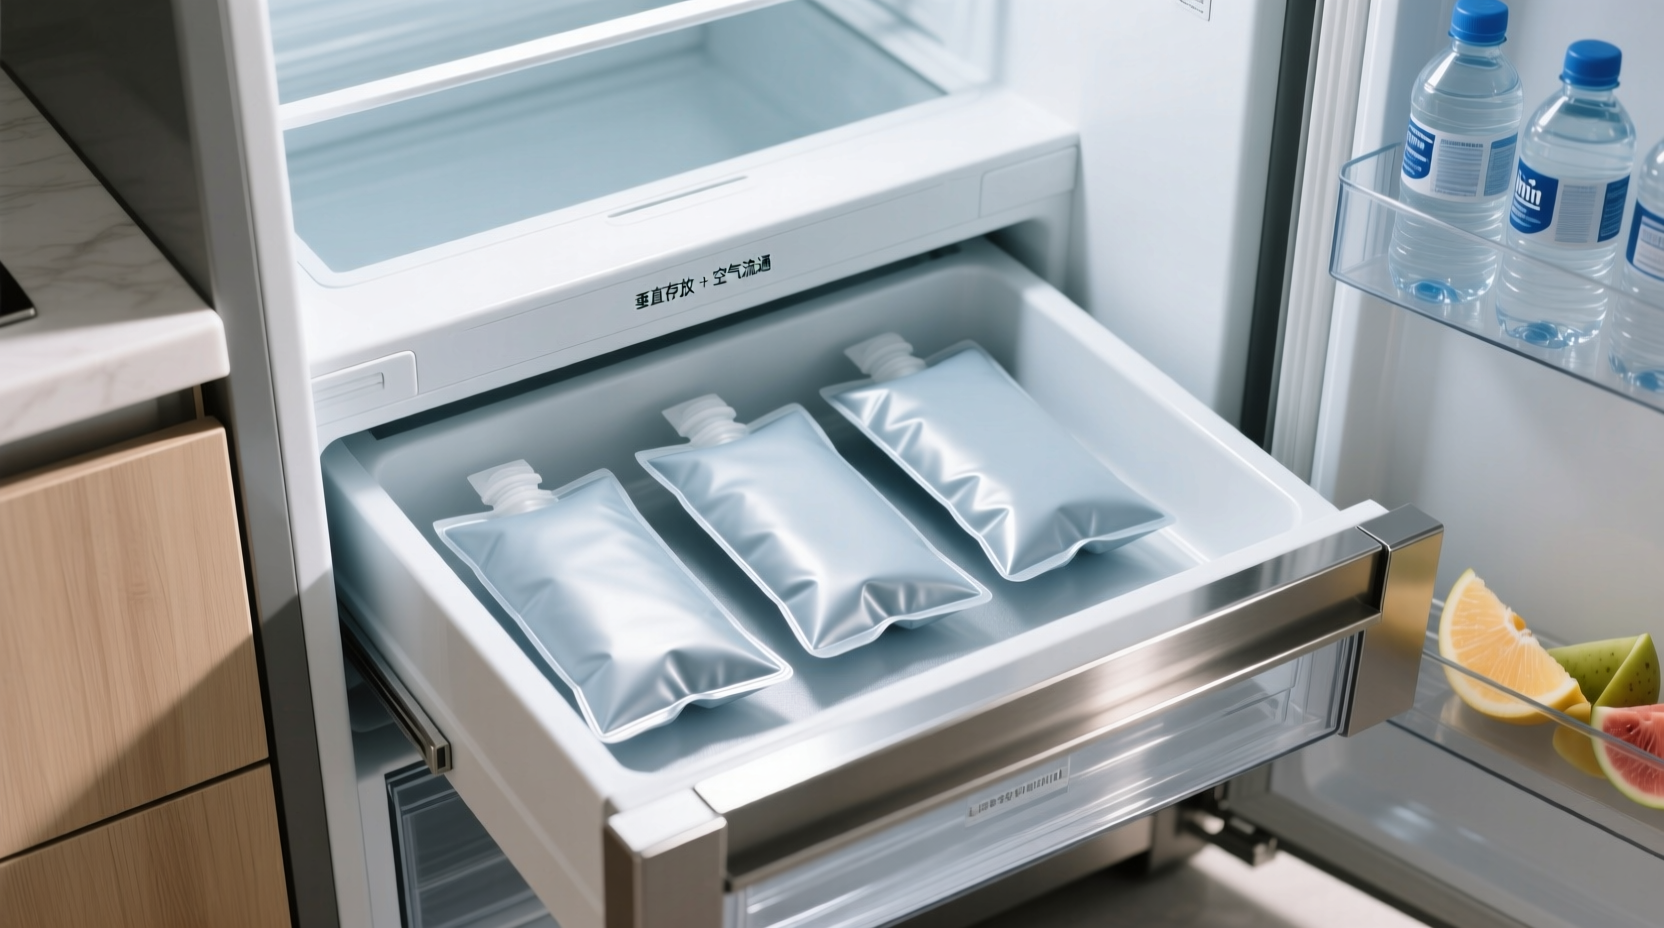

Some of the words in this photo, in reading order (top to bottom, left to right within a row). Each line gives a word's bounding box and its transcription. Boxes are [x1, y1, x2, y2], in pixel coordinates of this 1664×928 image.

[635, 276, 695, 310] 垂直存放
[712, 254, 771, 286] 空气流通
